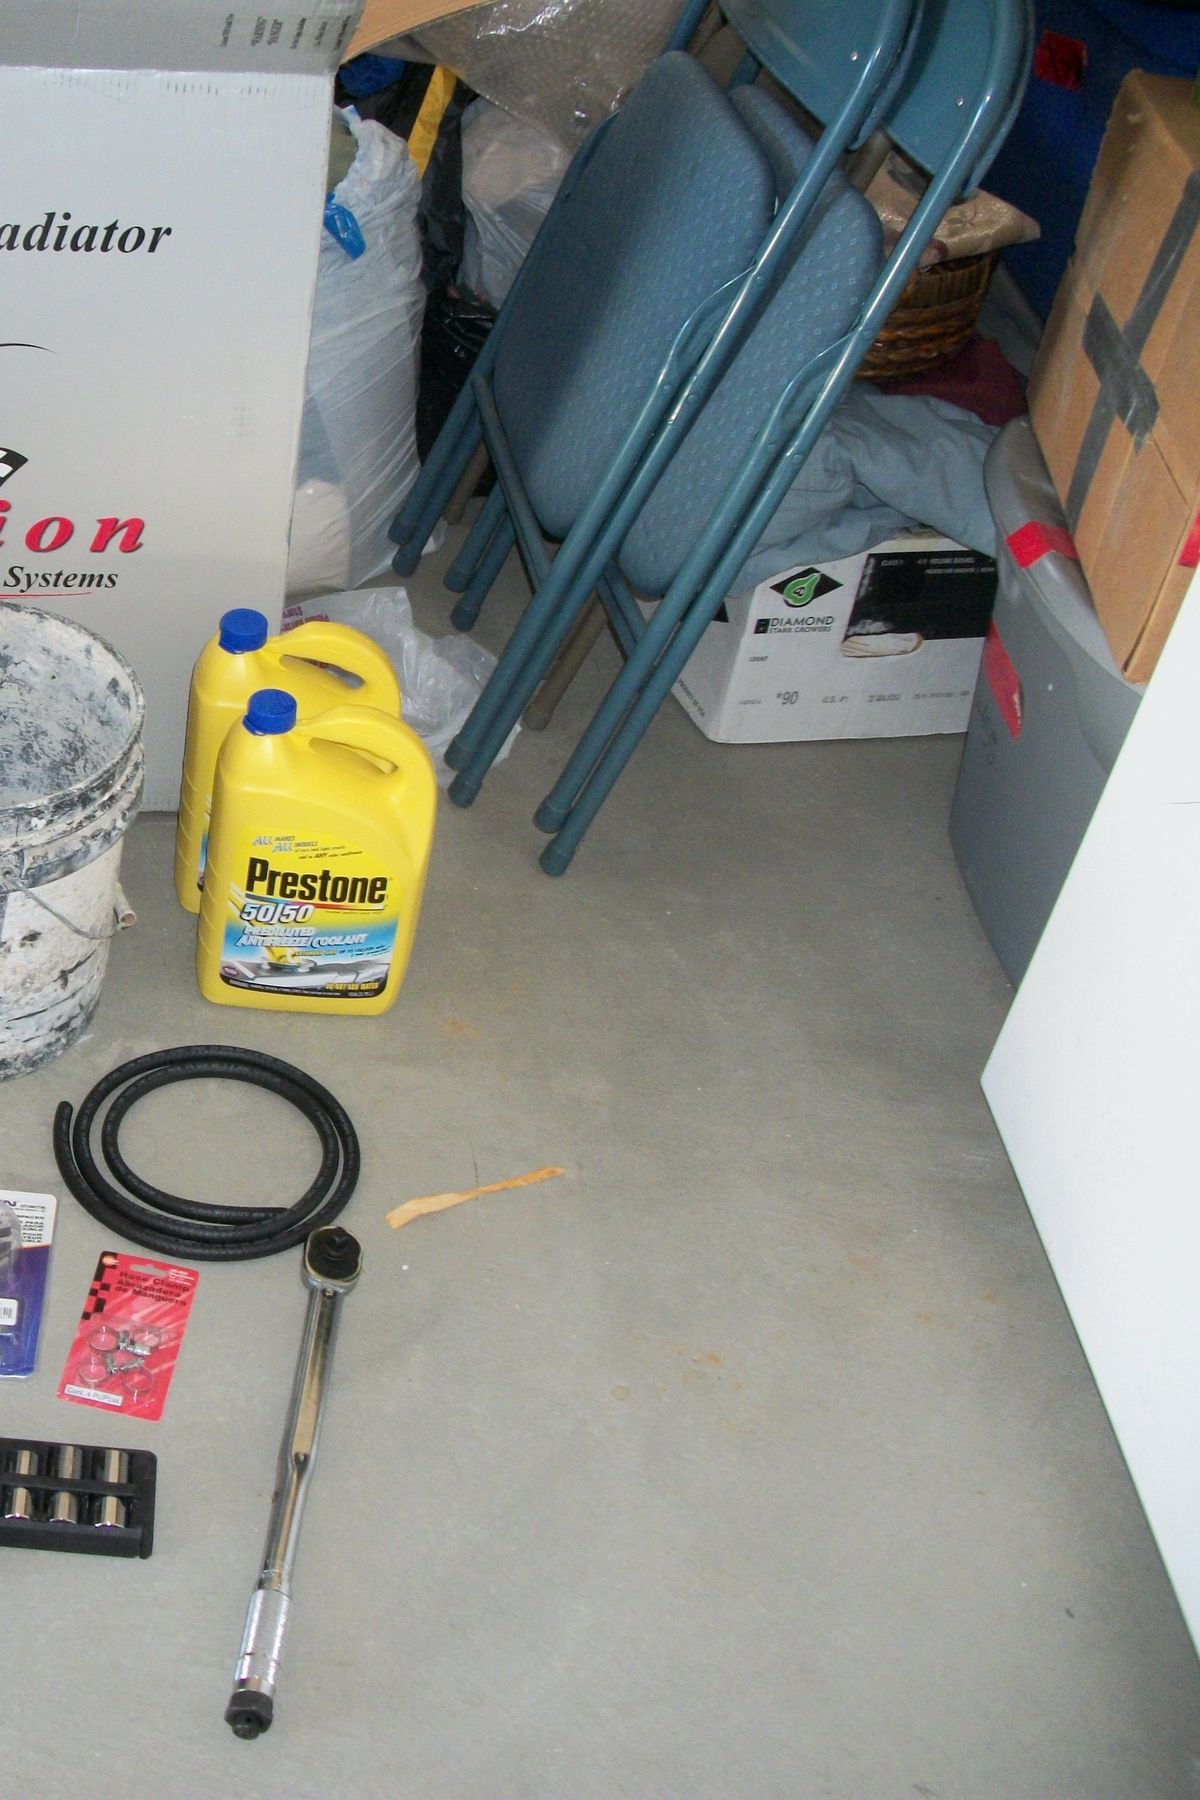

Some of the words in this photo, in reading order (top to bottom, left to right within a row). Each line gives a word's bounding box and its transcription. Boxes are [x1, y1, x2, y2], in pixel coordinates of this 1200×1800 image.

[2, 565, 119, 592] Systems
[770, 616, 834, 628] DIAMOND
[245, 857, 388, 904] Prestone
[240, 902, 315, 924] 50/50
[119, 1271, 149, 1282] Hose
[152, 1277, 190, 1293] Clamp
[114, 1285, 128, 1293] de
[132, 1288, 187, 1306] Manguera
